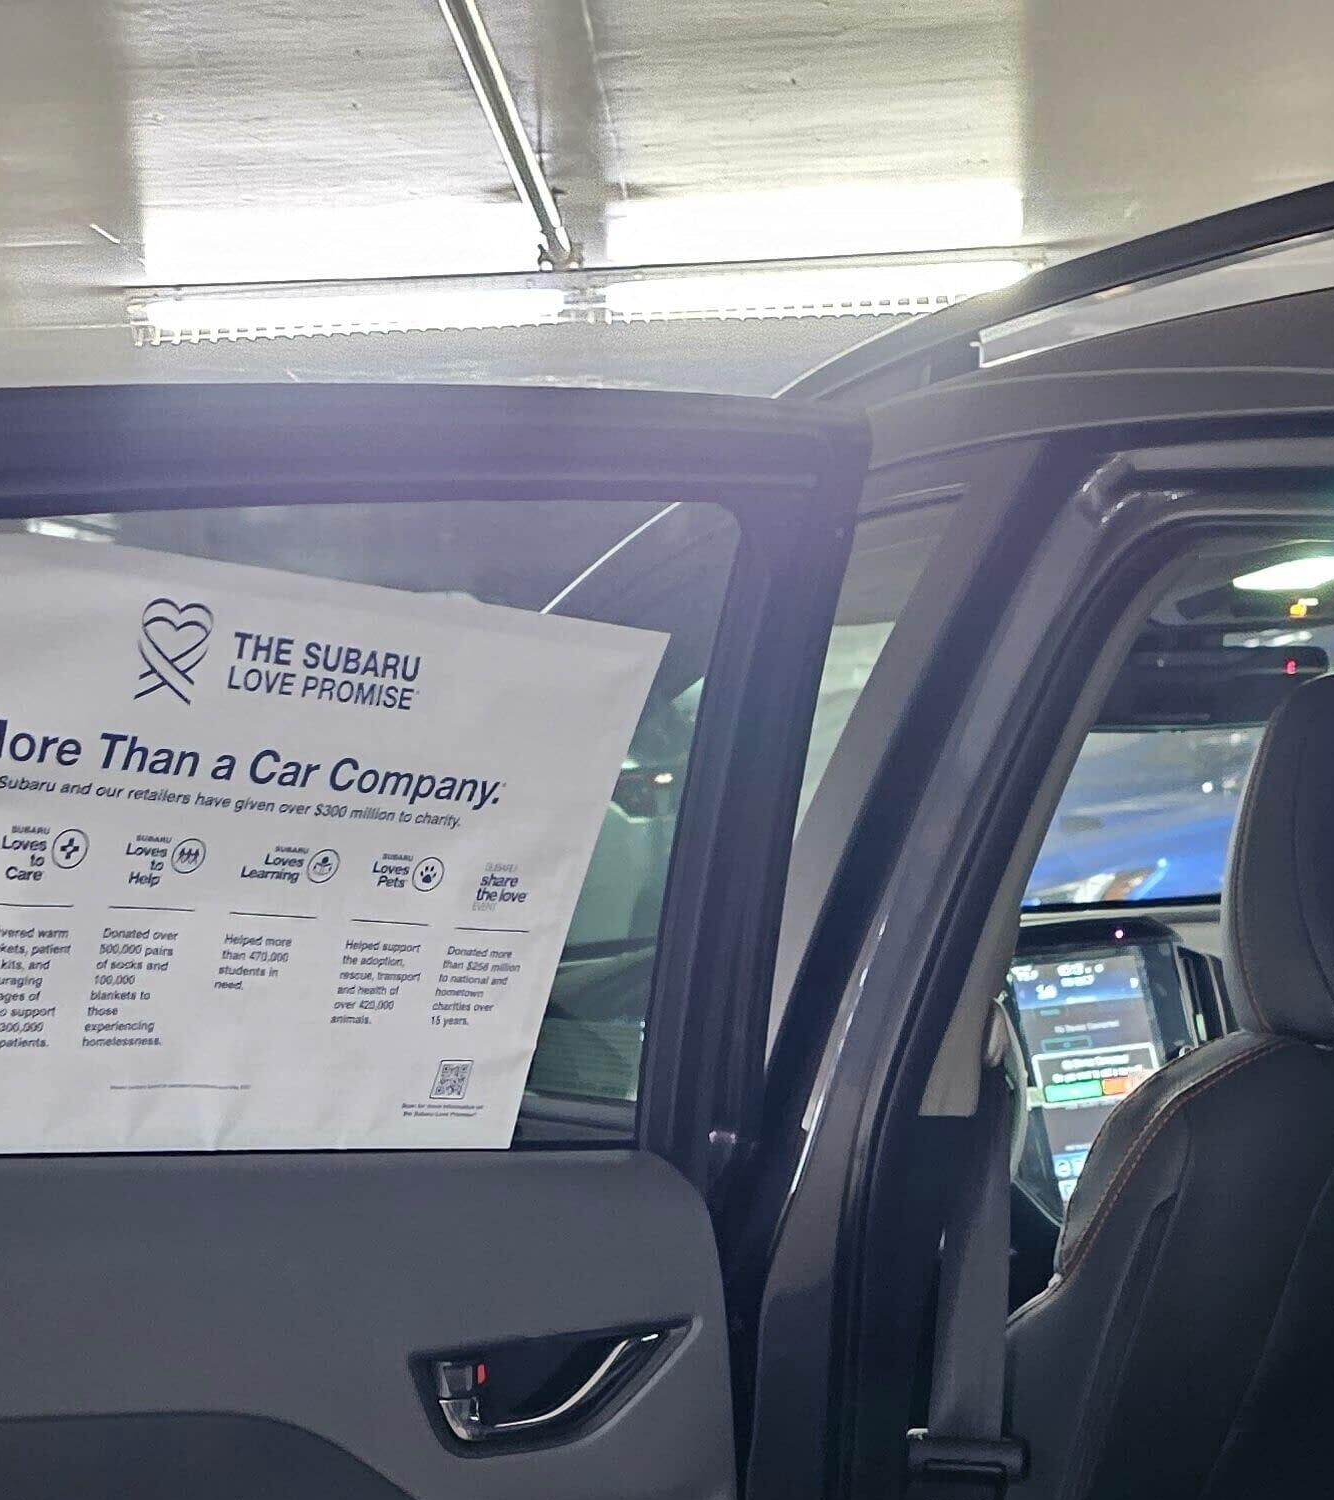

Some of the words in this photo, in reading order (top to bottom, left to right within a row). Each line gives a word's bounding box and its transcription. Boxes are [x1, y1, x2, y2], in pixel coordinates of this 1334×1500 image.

[234, 632, 294, 666] THE
[303, 643, 421, 682] SUBARU
[228, 666, 296, 697] LOVE
[302, 676, 413, 710] PROMISE
[99, 733, 200, 777] Than
[210, 754, 237, 780] a
[249, 749, 321, 789] Car
[329, 757, 501, 807] Company.
[60, 781, 93, 797] and
[96, 785, 124, 799] our
[128, 787, 191, 806] retailers
[195, 793, 231, 809] have
[235, 797, 275, 815] given
[280, 803, 312, 815] over
[313, 801, 349, 821] $300
[350, 805, 395, 823] million
[398, 811, 411, 825] to
[414, 813, 462, 830] charity.
[11, 825, 51, 835] SUBARU
[1, 835, 47, 851] Loves
[136, 834, 172, 844] SUBARU
[125, 842, 167, 857] Loves
[275, 845, 309, 855] SUBARU
[30, 854, 45, 867] to
[264, 853, 304, 868] Loves
[382, 853, 414, 862] SUBARU
[150, 859, 164, 872] to
[372, 860, 410, 876] Loves
[5, 866, 43, 881] Care
[128, 871, 161, 888] Help
[240, 866, 300, 884] Learning
[376, 875, 406, 889] Pets
[479, 873, 519, 888] share
[476, 887, 498, 901] the
[498, 890, 527, 903] love
[38, 928, 69, 939] warm
[102, 927, 150, 940] Donated
[152, 931, 178, 941] over
[224, 933, 263, 948] Helped
[264, 937, 292, 948] more
[345, 940, 381, 953] Helped
[382, 943, 421, 954] support
[31, 944, 71, 957] patient
[99, 943, 143, 956] 500,000
[144, 945, 174, 958] pairs
[222, 949, 247, 961] than
[447, 945, 489, 959] Donated
[490, 950, 513, 960] more
[28, 960, 51, 971] and
[96, 959, 108, 970] of
[110, 960, 143, 971] socks
[146, 961, 169, 973] and
[342, 954, 358, 966] the
[443, 959, 465, 971] than
[491, 963, 522, 974] million
[218, 964, 267, 977] students
[268, 966, 279, 978] in
[377, 971, 421, 984] transport
[94, 974, 136, 987] 100,000
[439, 974, 449, 984] to
[450, 974, 490, 986] national
[491, 977, 509, 987] and
[28, 990, 41, 1002] of
[90, 990, 137, 1002] blankets
[139, 991, 151, 1001] to
[337, 985, 356, 996] and
[358, 985, 388, 996] health
[389, 985, 400, 996] of
[435, 987, 484, 999] hometown
[87, 1006, 119, 1017] those
[333, 1001, 357, 1011] over
[432, 1001, 472, 1012] charities
[473, 1003, 494, 1013] over
[10, 1007, 56, 1019] support
[431, 1014, 442, 1026] 15
[84, 1020, 155, 1034] experiencing
[82, 1036, 163, 1048] homelessness.
